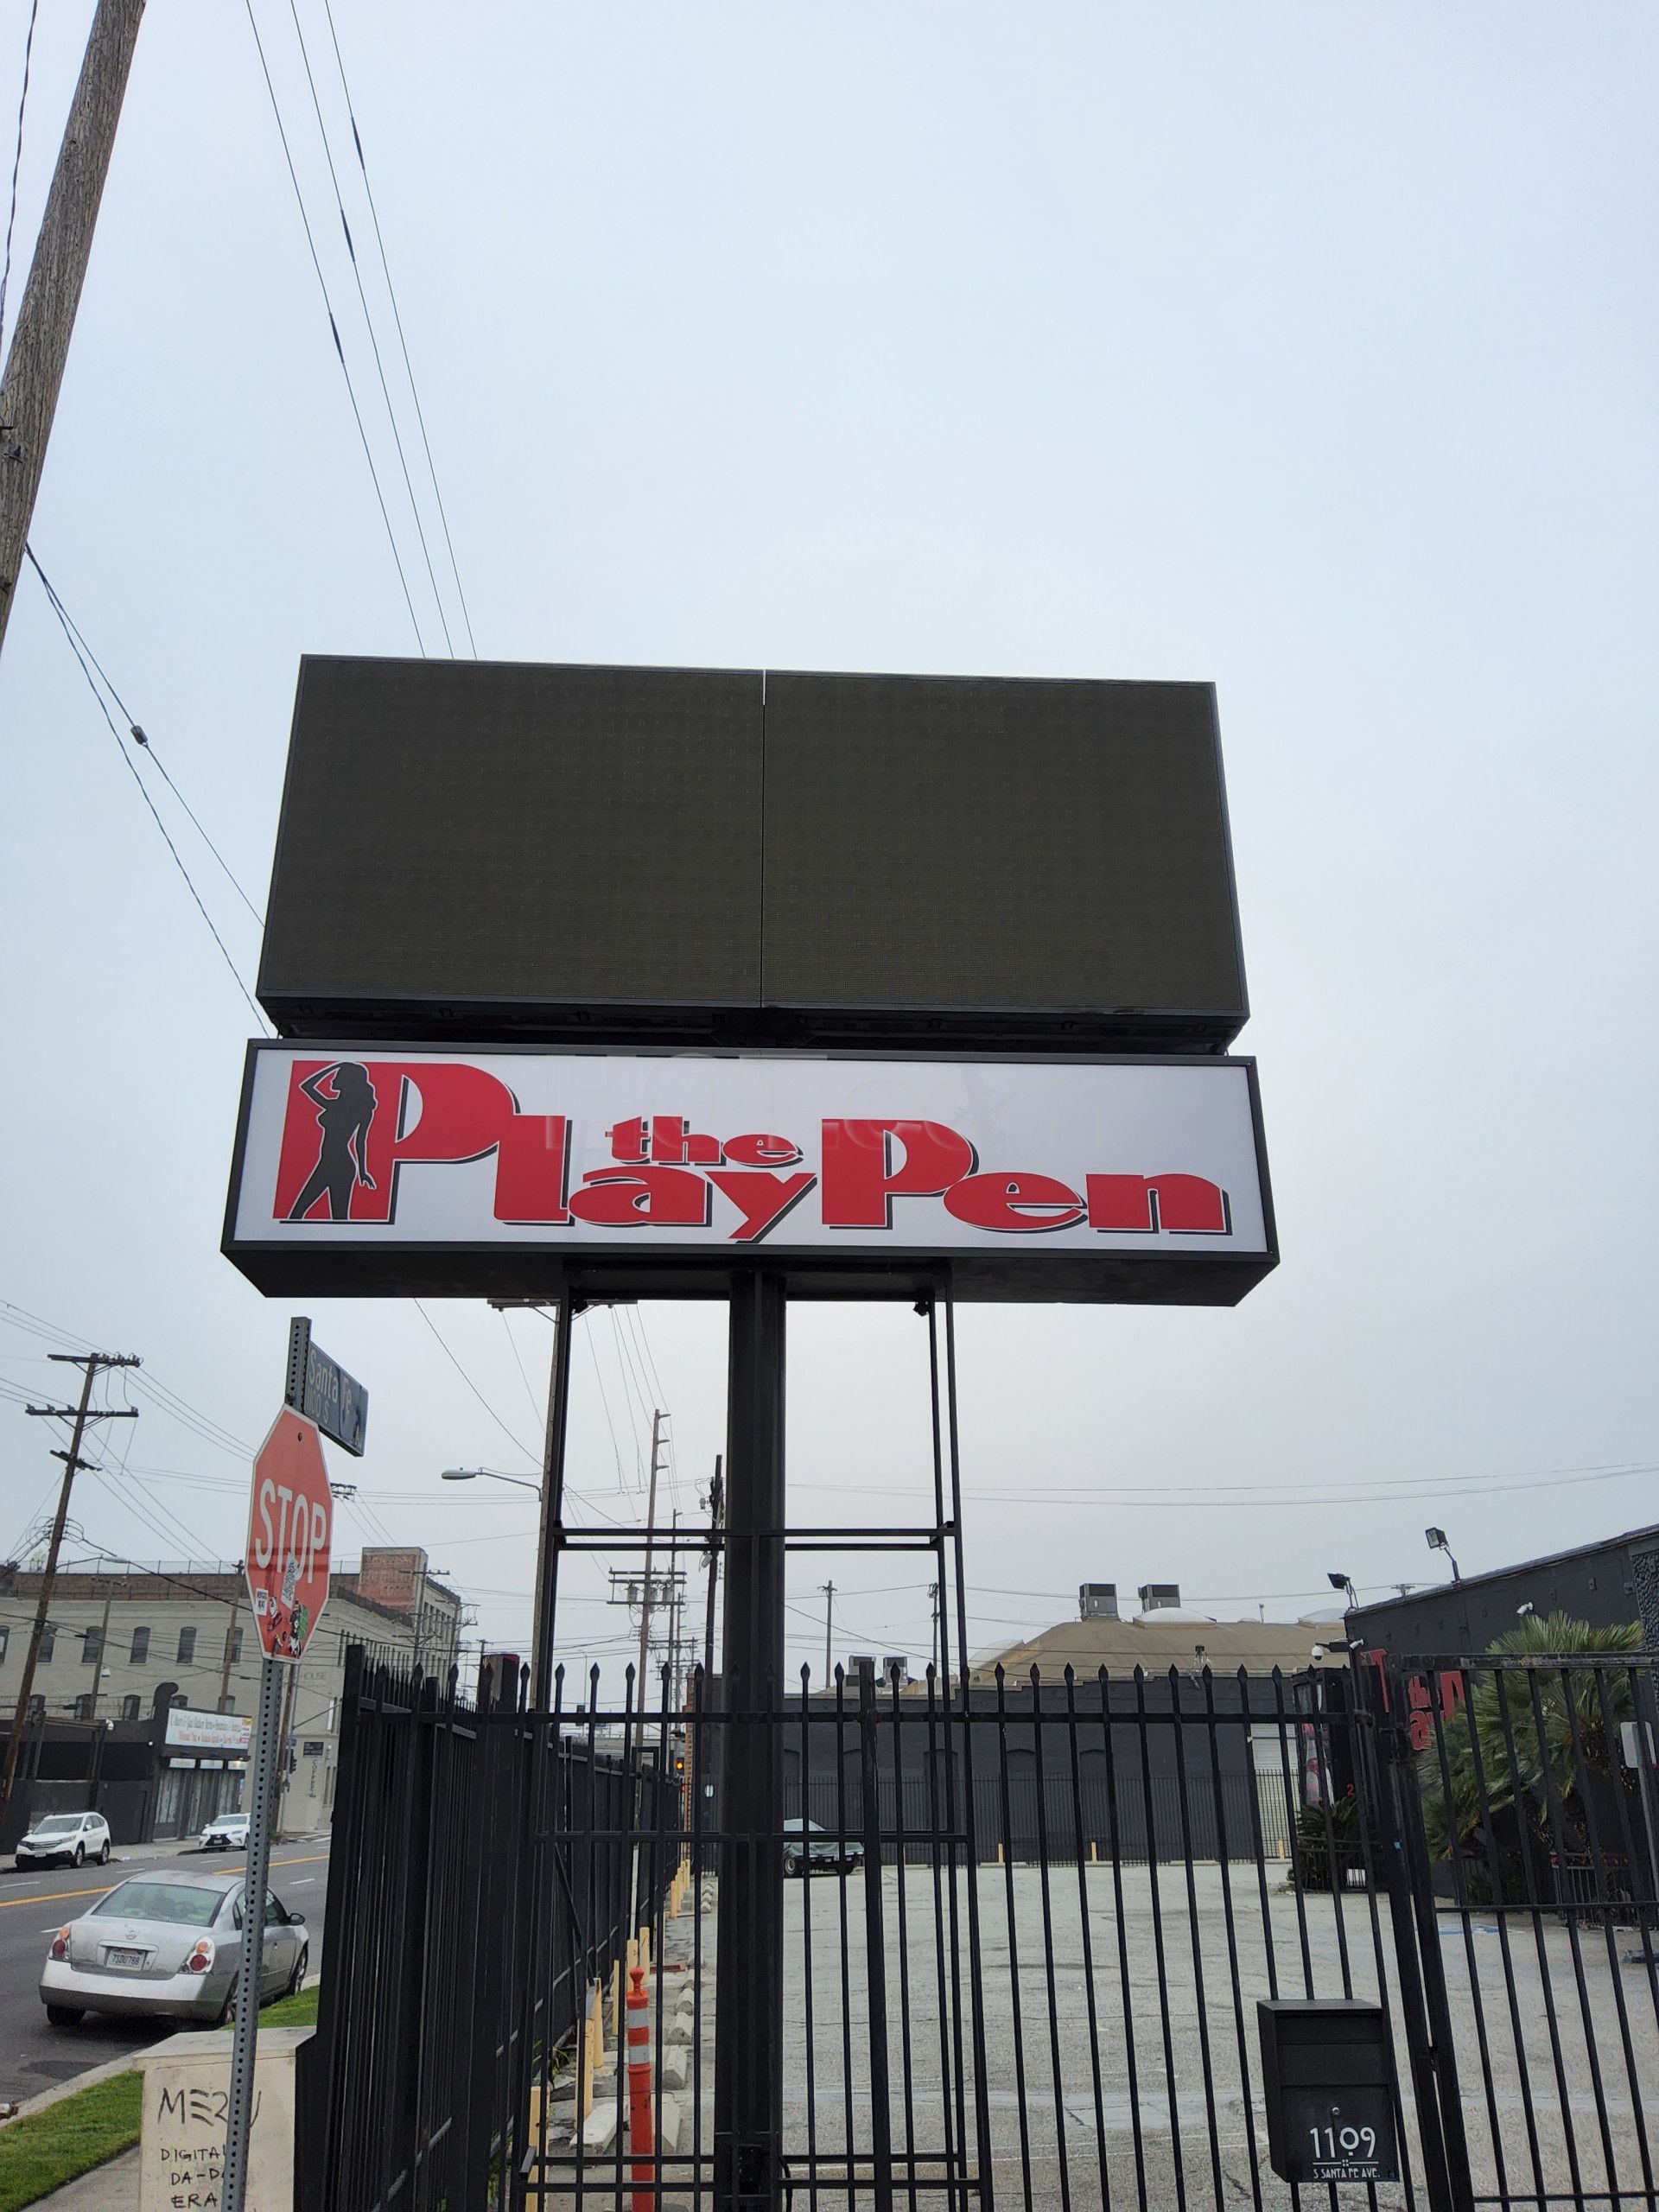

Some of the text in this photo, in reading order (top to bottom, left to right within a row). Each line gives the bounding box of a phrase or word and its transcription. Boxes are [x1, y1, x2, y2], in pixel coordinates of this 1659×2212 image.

[272, 1060, 1233, 1243] Play Pen
[605, 1116, 804, 1166] the
[308, 1349, 352, 1415] Santa Fe
[323, 1400, 329, 1424] S
[256, 1478, 326, 1584] STOP
[1309, 2126, 1376, 2158] 1109
[170, 2167, 226, 2186] DA-D
[1313, 2166, 1381, 2179] S SANTA FE AVE.
[170, 2191, 219, 2209] ERA
